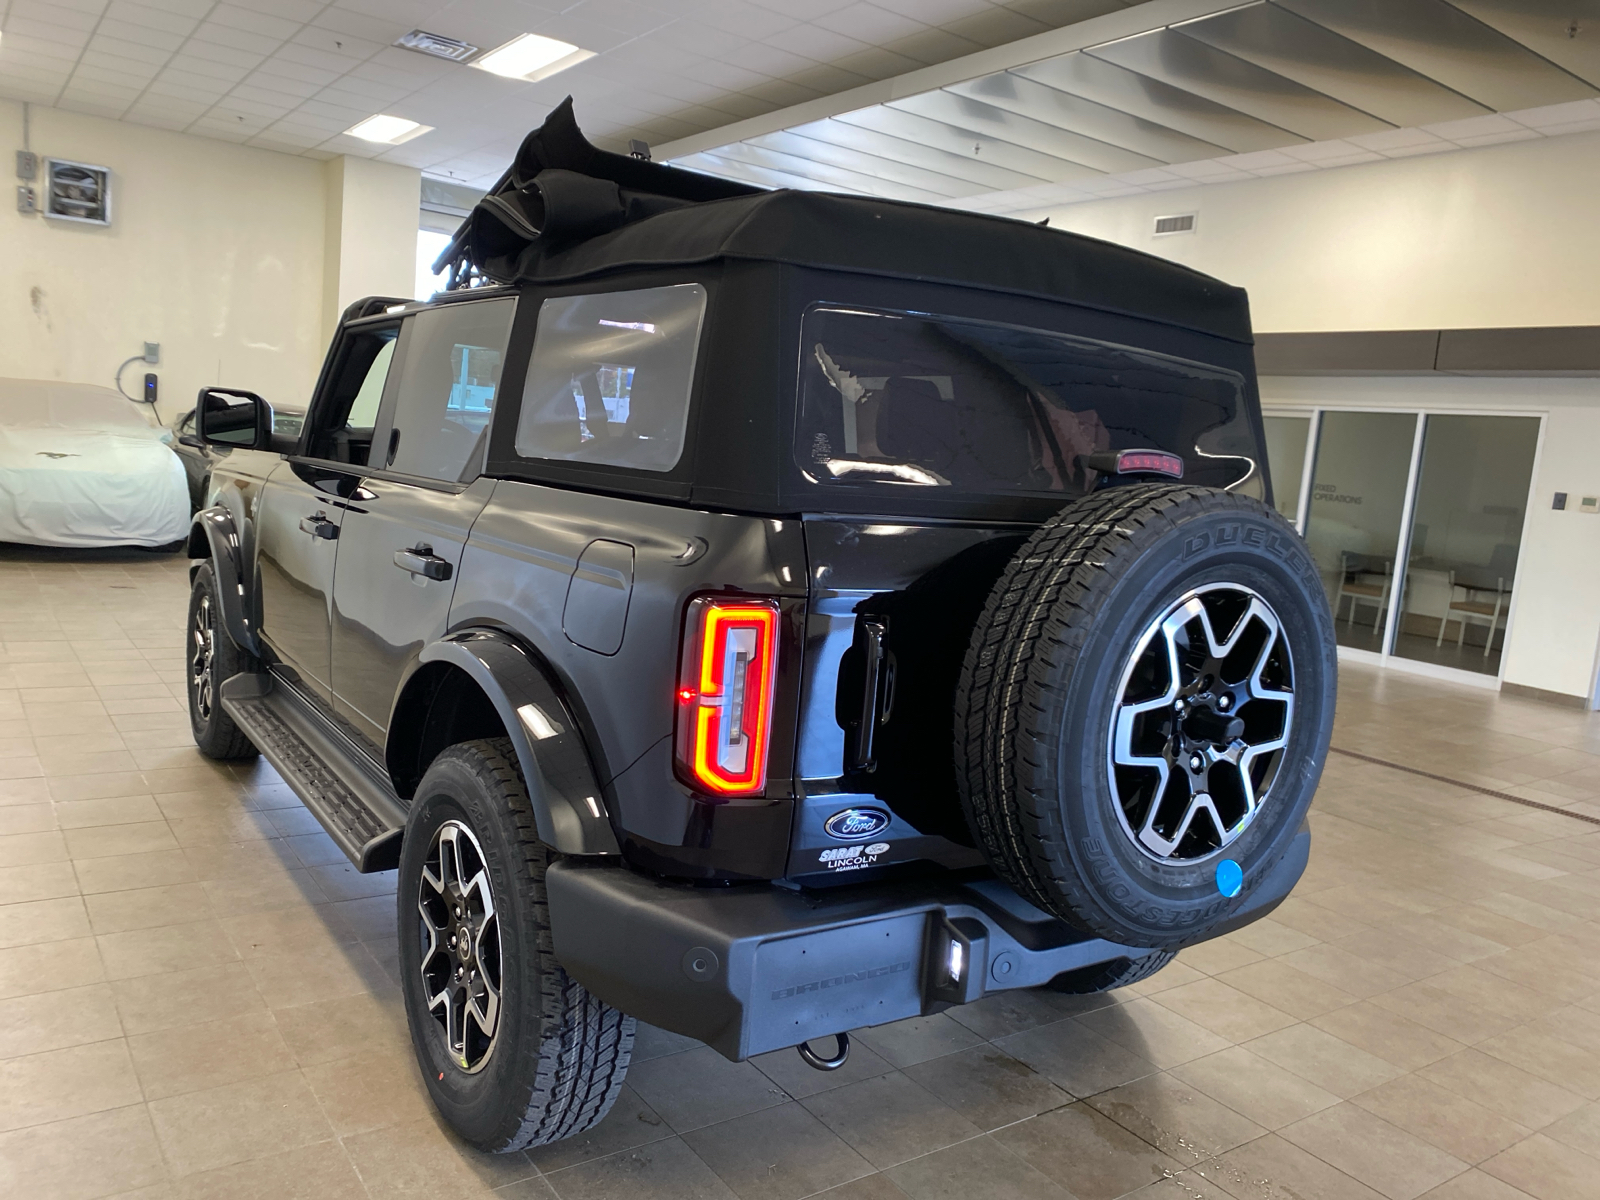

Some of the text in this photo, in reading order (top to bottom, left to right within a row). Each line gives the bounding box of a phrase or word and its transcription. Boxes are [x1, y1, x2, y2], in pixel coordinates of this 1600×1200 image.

[1315, 484, 1337, 493] FIXED
[1314, 493, 1363, 505] OPERATIONS
[1182, 522, 1323, 601] DUELER
[842, 815, 876, 833] Ford
[819, 845, 864, 862] SARAT
[828, 855, 877, 868] LINCOLN
[771, 961, 911, 1000] BRONCO
